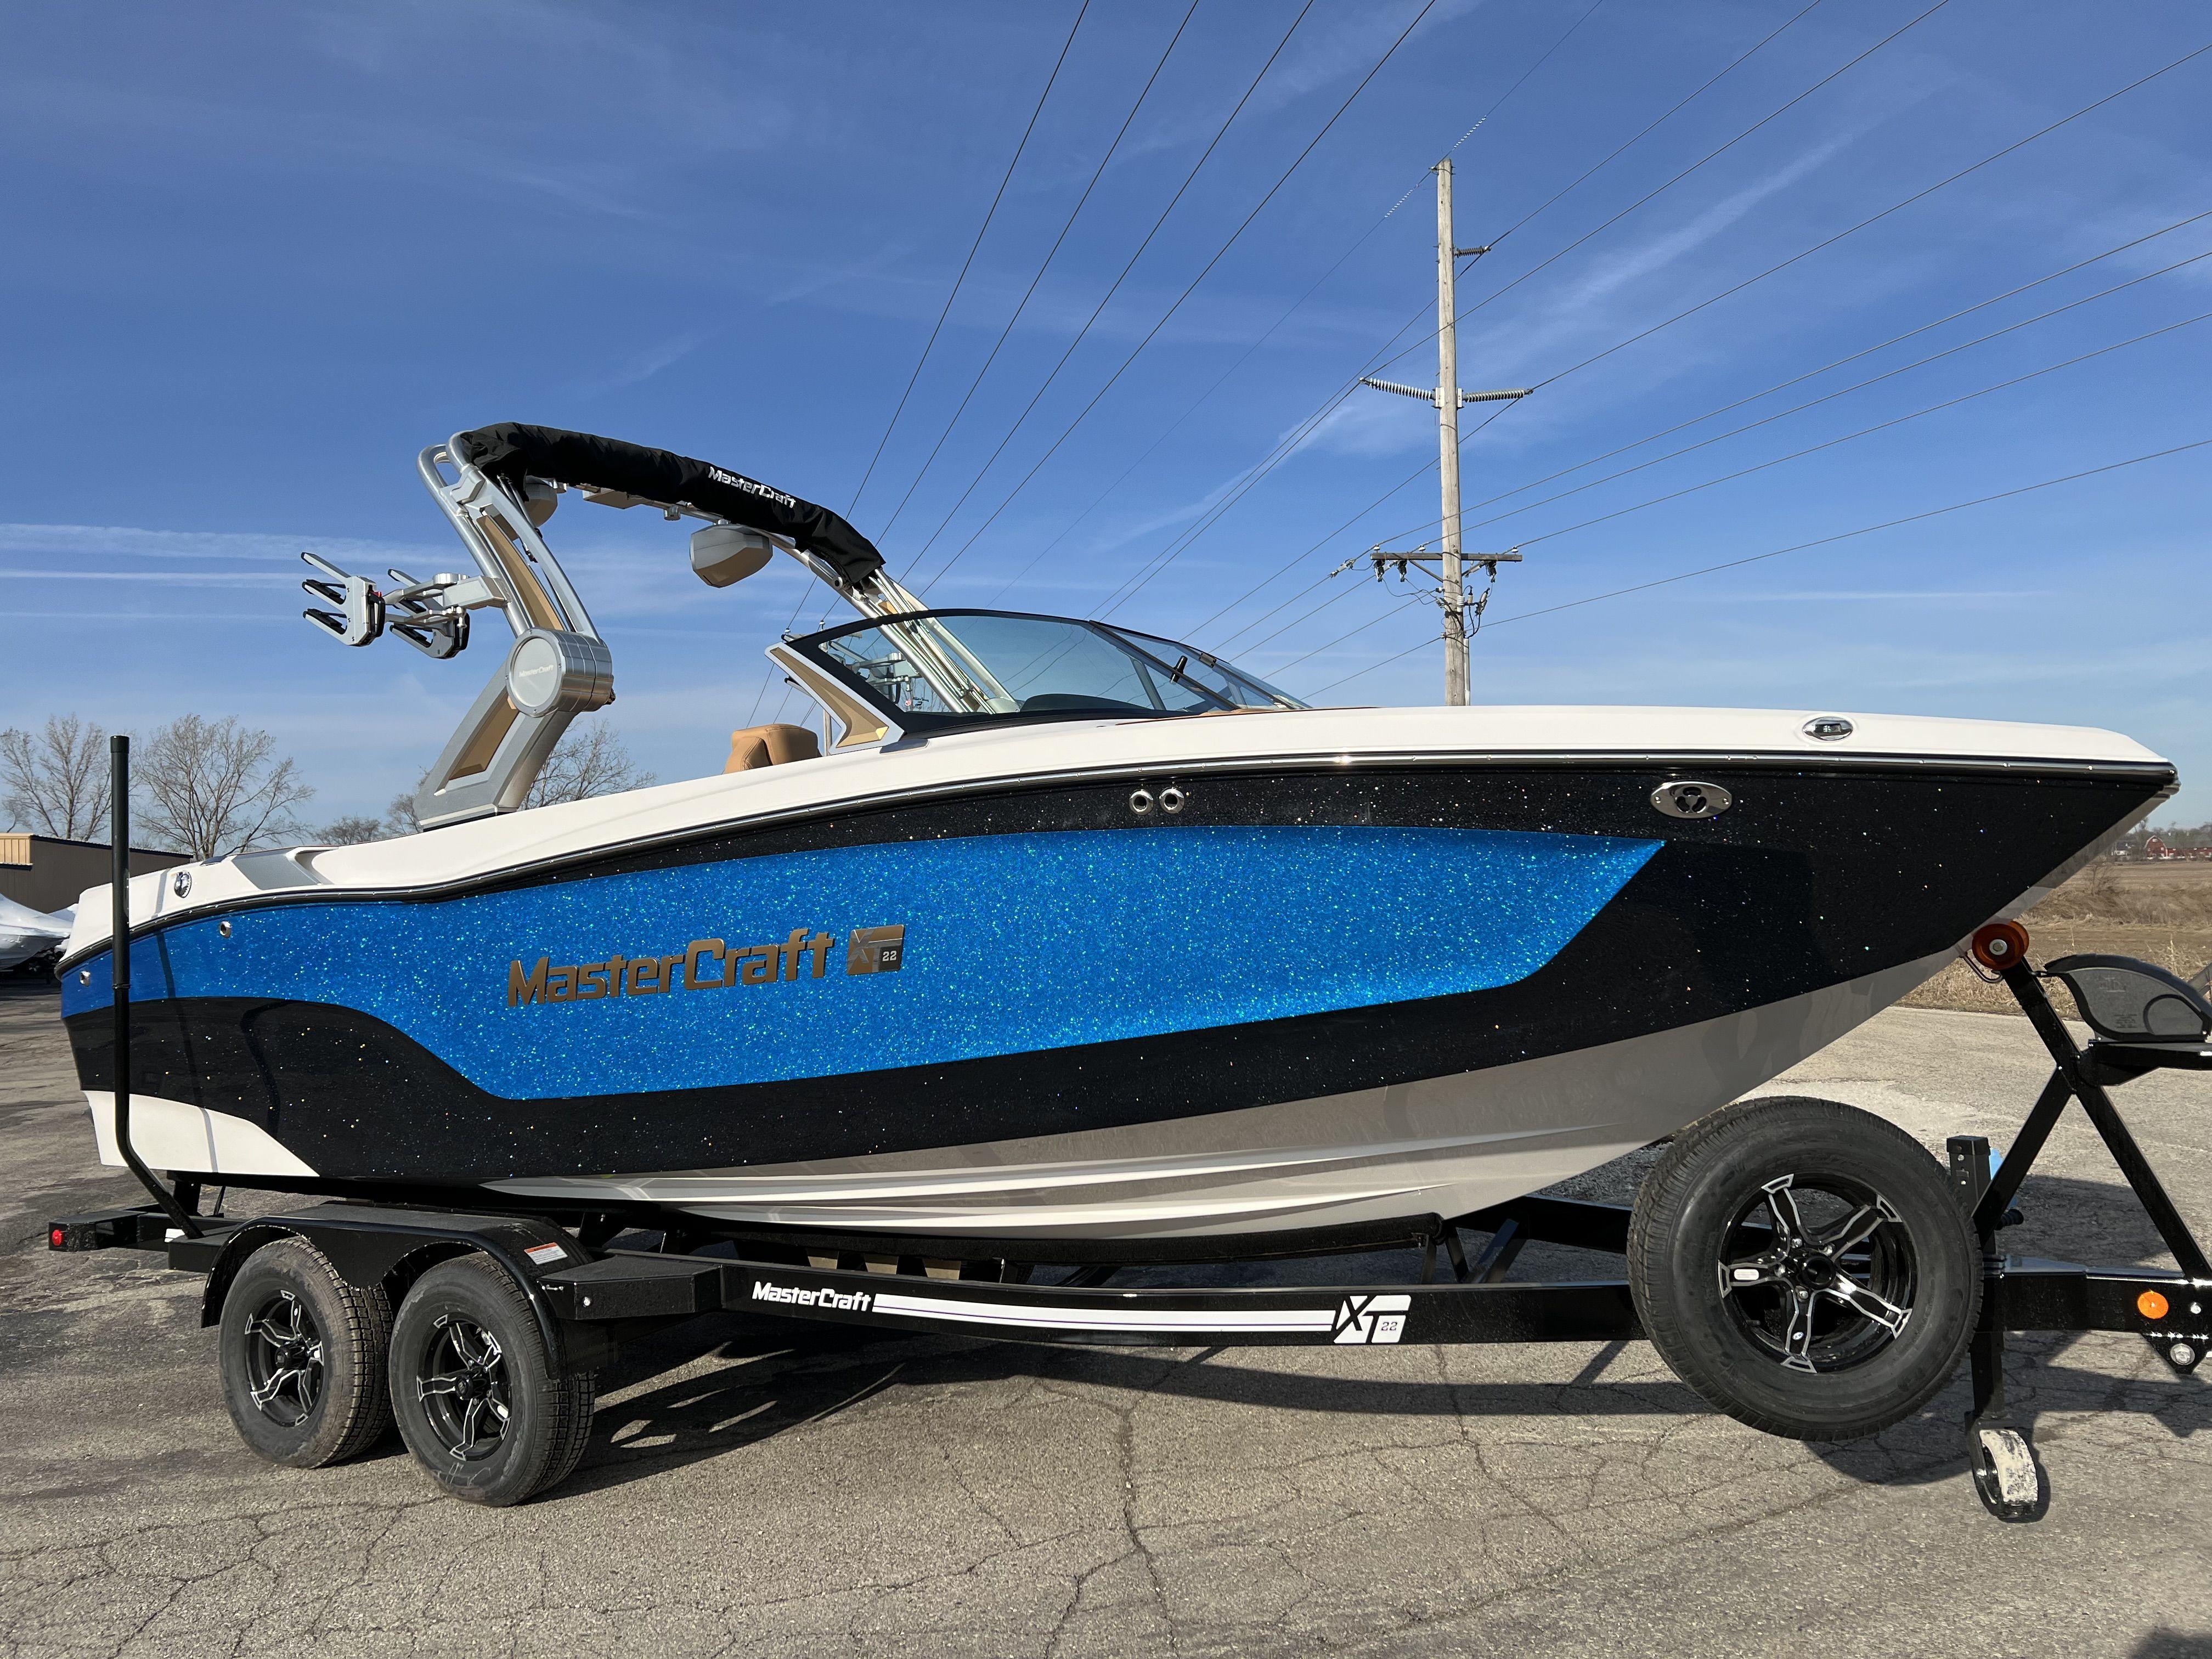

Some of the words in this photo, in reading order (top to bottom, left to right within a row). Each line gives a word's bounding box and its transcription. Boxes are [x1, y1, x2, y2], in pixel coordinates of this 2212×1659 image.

[708, 466, 796, 509] MasterCraft
[506, 928, 835, 1007] MasterCraft
[882, 950, 897, 962] 22
[752, 1281, 871, 1312] MasterCraft
[1332, 1295, 1409, 1344] XT
[1381, 1321, 1398, 1331] 22
